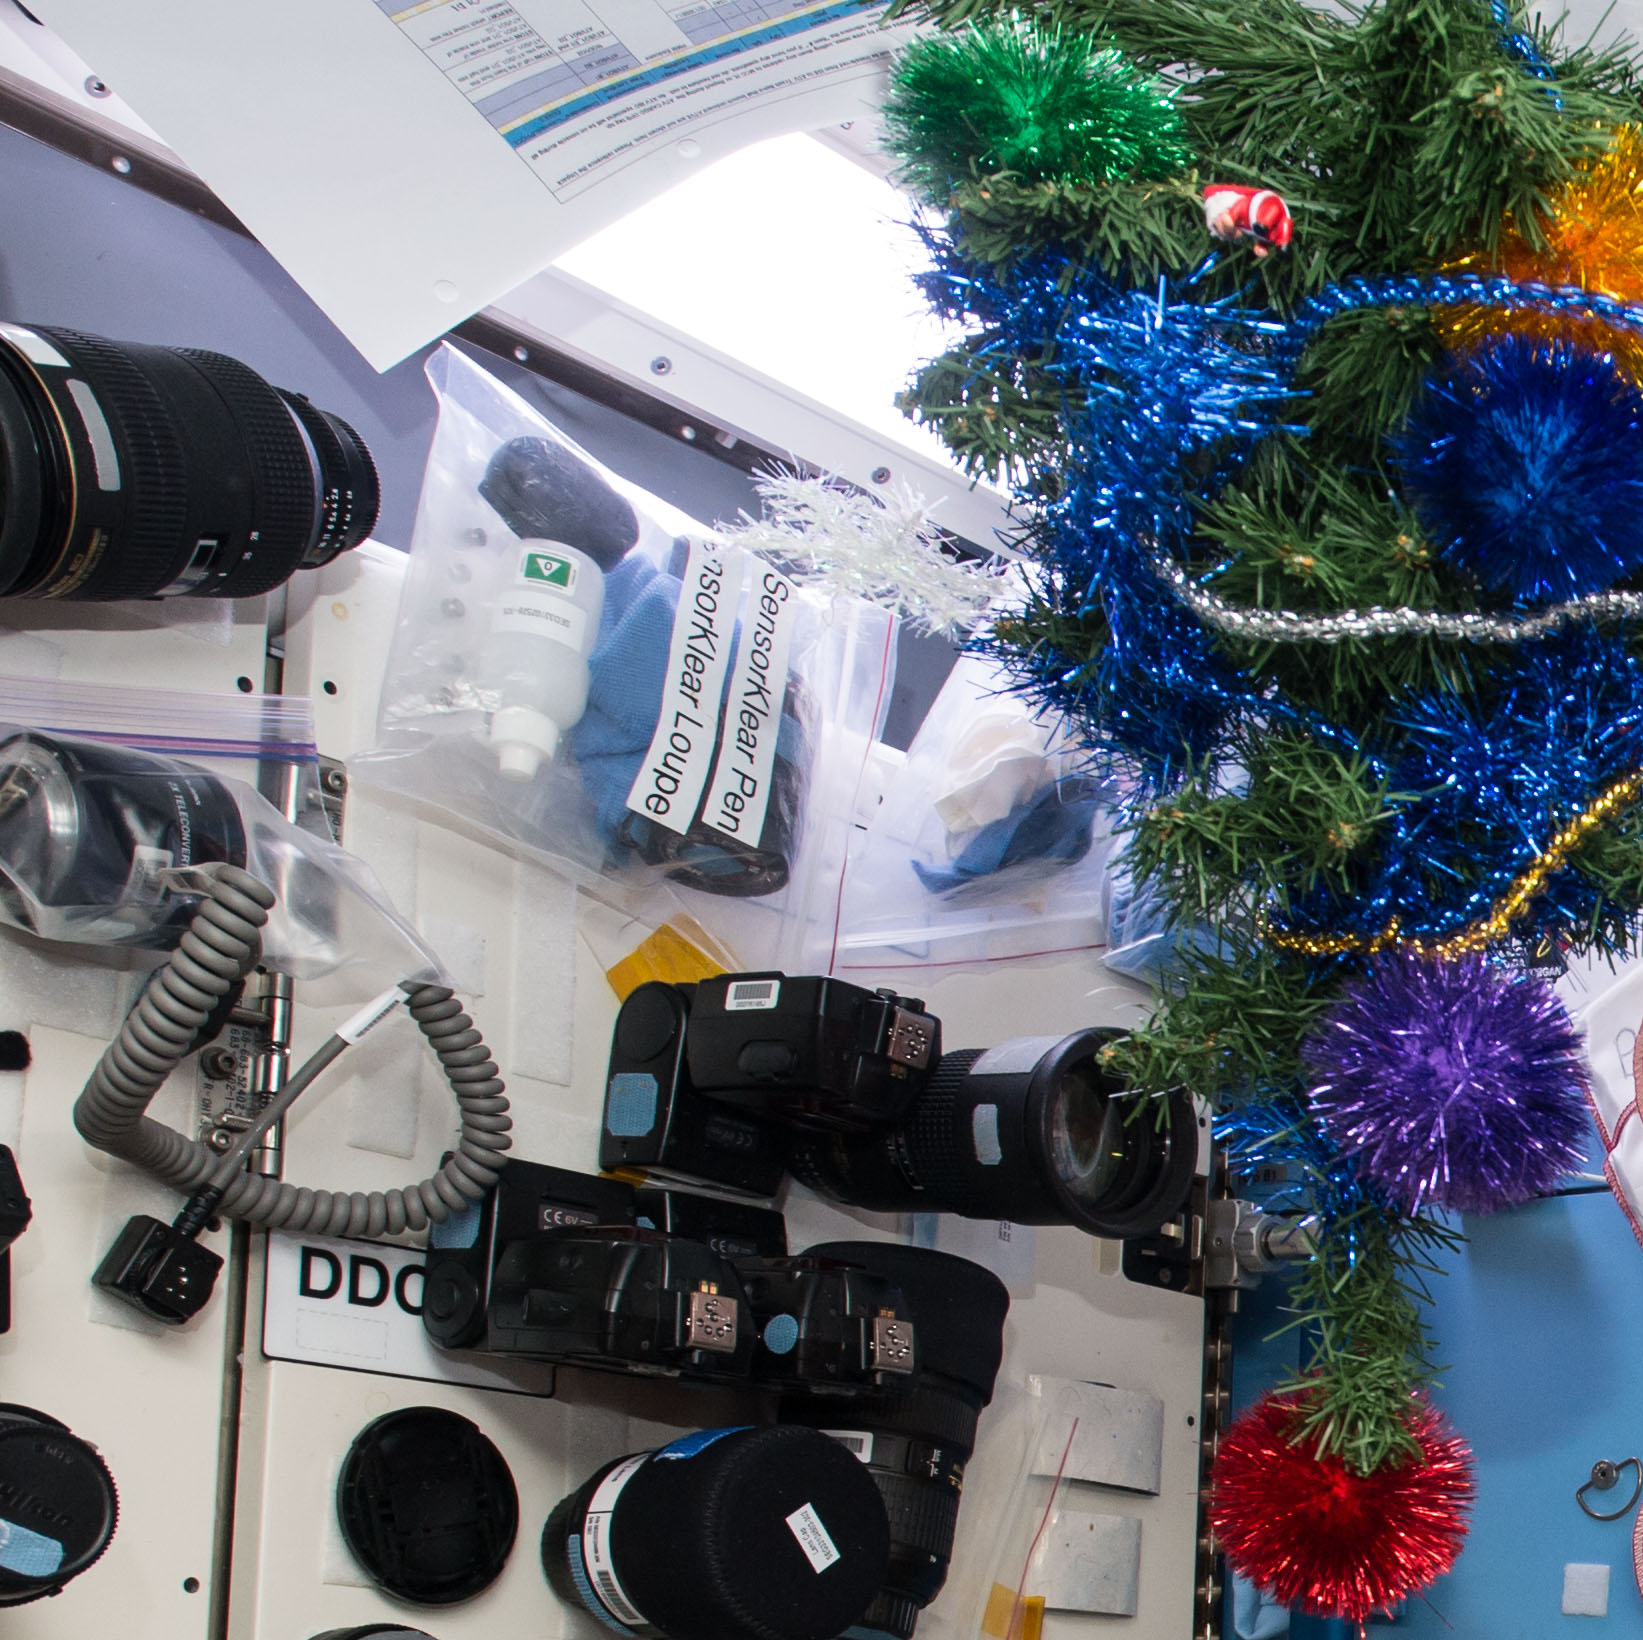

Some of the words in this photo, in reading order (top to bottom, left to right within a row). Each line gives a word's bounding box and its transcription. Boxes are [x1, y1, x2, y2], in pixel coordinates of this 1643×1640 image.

[735, 573, 789, 765] SensorKlear
[645, 711, 704, 816] Loupe
[716, 767, 758, 833] Pen
